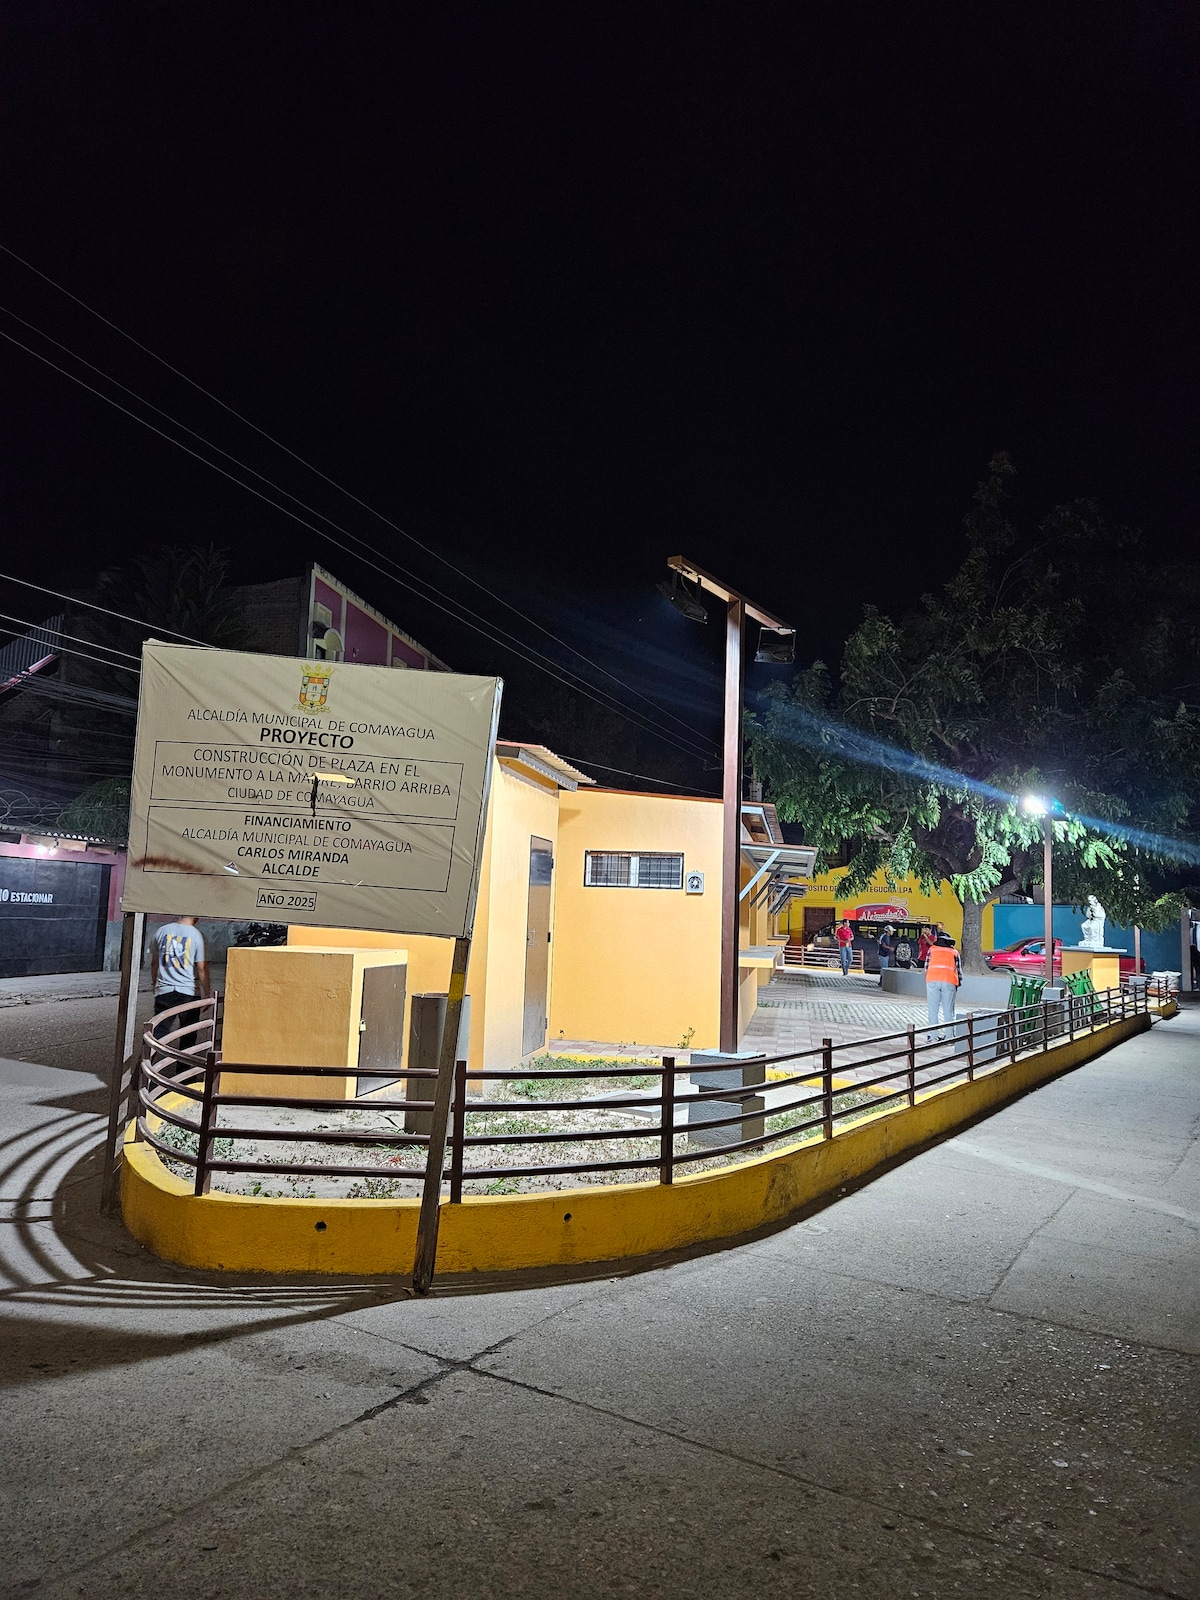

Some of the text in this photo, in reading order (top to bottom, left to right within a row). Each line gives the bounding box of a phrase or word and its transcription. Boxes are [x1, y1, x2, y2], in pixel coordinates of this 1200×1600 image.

[187, 709, 435, 740] ALCALDÍA MUNICIPAL DE COMAYAGUA
[259, 727, 354, 749] PROYECTO
[193, 748, 421, 778] CONSTRUCCIÓN DE PLAZA EN EL
[162, 765, 253, 781] MONUMENTO
[256, 769, 265, 781] A
[269, 770, 284, 783] LA
[400, 782, 451, 796] ARRIBA
[227, 787, 375, 808] CIUDAD DE COMAYAGUA
[244, 815, 351, 832] FINANCIAMIENTO
[182, 827, 413, 854] ALCALDÍA MUNICIPAL DE COMAYAGUA
[237, 846, 349, 864] CARLOS MIRANDA
[261, 863, 320, 878] ALCALDE
[10, 892, 53, 903] ESTACIONAR
[258, 891, 315, 908] AÑO 2025
